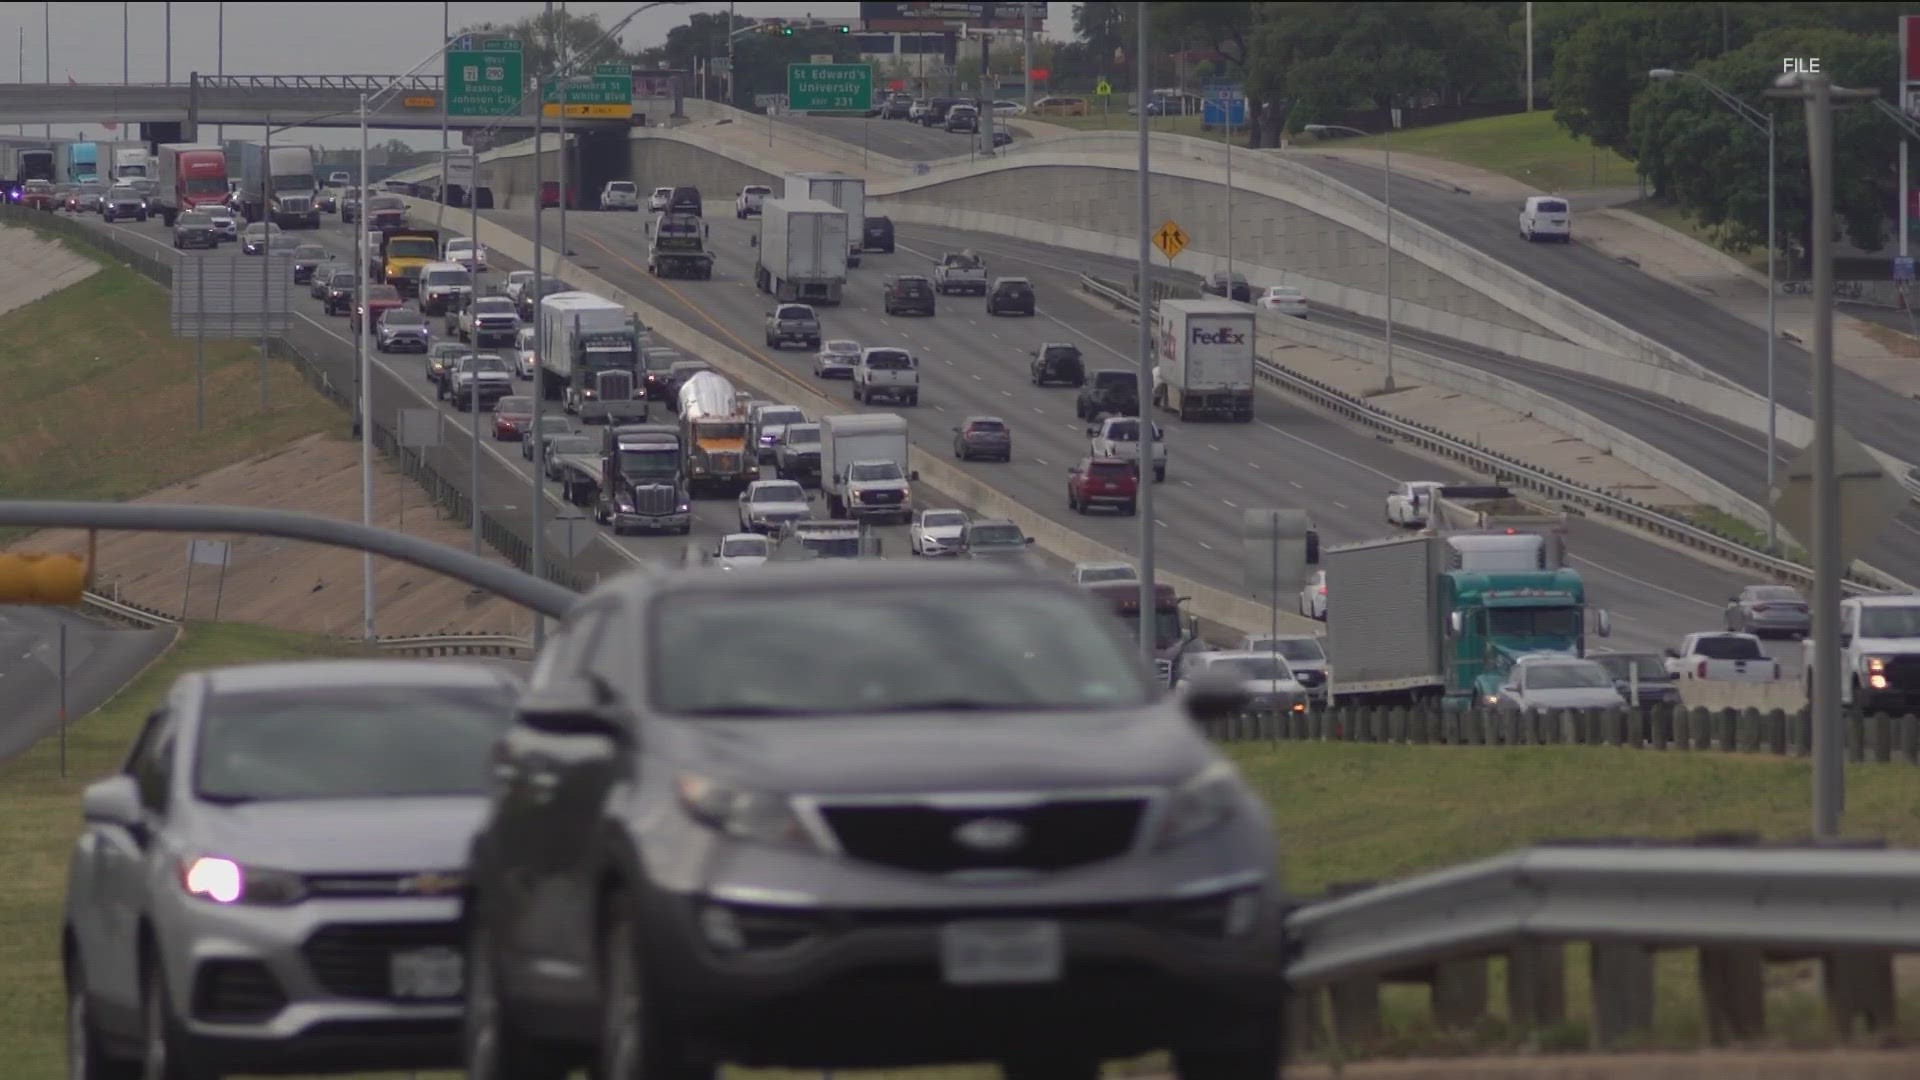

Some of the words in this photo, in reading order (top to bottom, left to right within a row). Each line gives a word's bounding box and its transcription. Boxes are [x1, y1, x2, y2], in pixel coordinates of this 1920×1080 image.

[487, 69, 502, 78] 290
[794, 68, 806, 79] St
[812, 68, 866, 79] Edward's
[466, 84, 503, 94] Bastrop
[799, 82, 860, 95] University
[498, 96, 516, 104] City
[572, 92, 600, 100] White
[604, 92, 626, 100] Blvd
[834, 97, 853, 106] 231
[1192, 327, 1245, 344] FedEx
